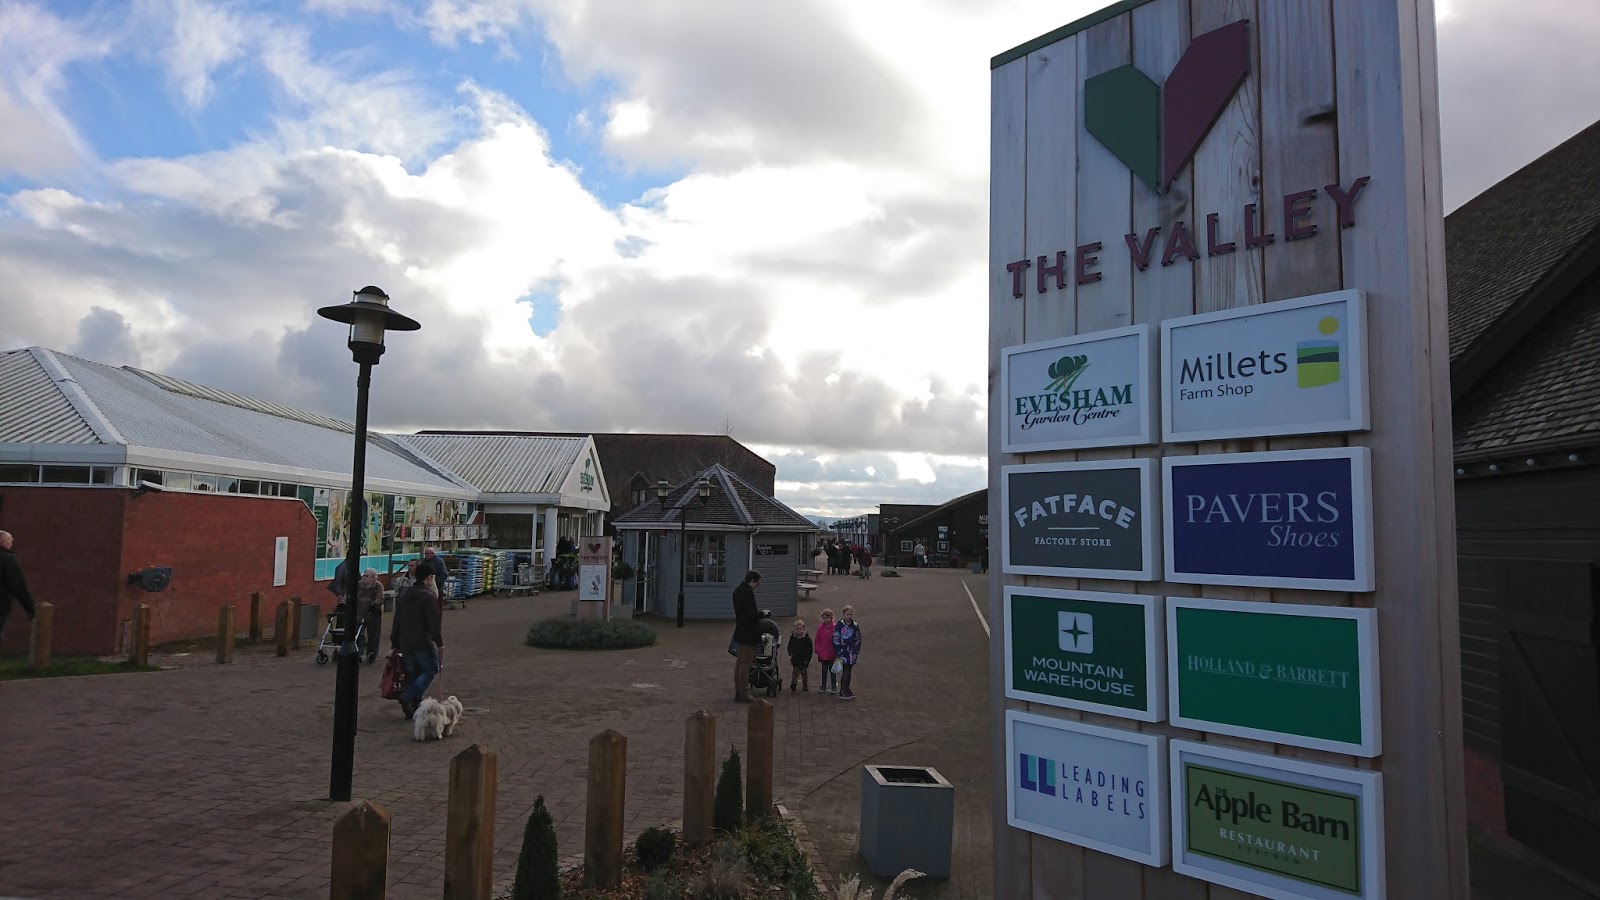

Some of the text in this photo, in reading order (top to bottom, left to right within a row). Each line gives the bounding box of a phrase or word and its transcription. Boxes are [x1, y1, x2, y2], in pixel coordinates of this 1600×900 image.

[1006, 175, 1371, 298] THE VALLEY
[1179, 349, 1288, 385] Millets
[1015, 384, 1133, 416] EVESHAM
[1180, 383, 1254, 401] Farm Shop
[1021, 404, 1120, 430] Garden Centre
[1014, 493, 1136, 530] FATFACE
[1186, 491, 1340, 523] PAVERS
[1034, 536, 1112, 547] FACTORY STORE
[1267, 525, 1340, 548] Shoes
[1024, 669, 1135, 696] WAREHOUSE
[1032, 656, 1124, 680] MOUNTAIN
[1188, 655, 1349, 688] HOLLAND & BARRETT
[1062, 762, 1145, 798] LEADING
[1215, 786, 1229, 796] THE
[1062, 784, 1145, 820] LABELS
[1194, 783, 1349, 841] Apple Barn
[1219, 827, 1320, 861] RESTAURANT
